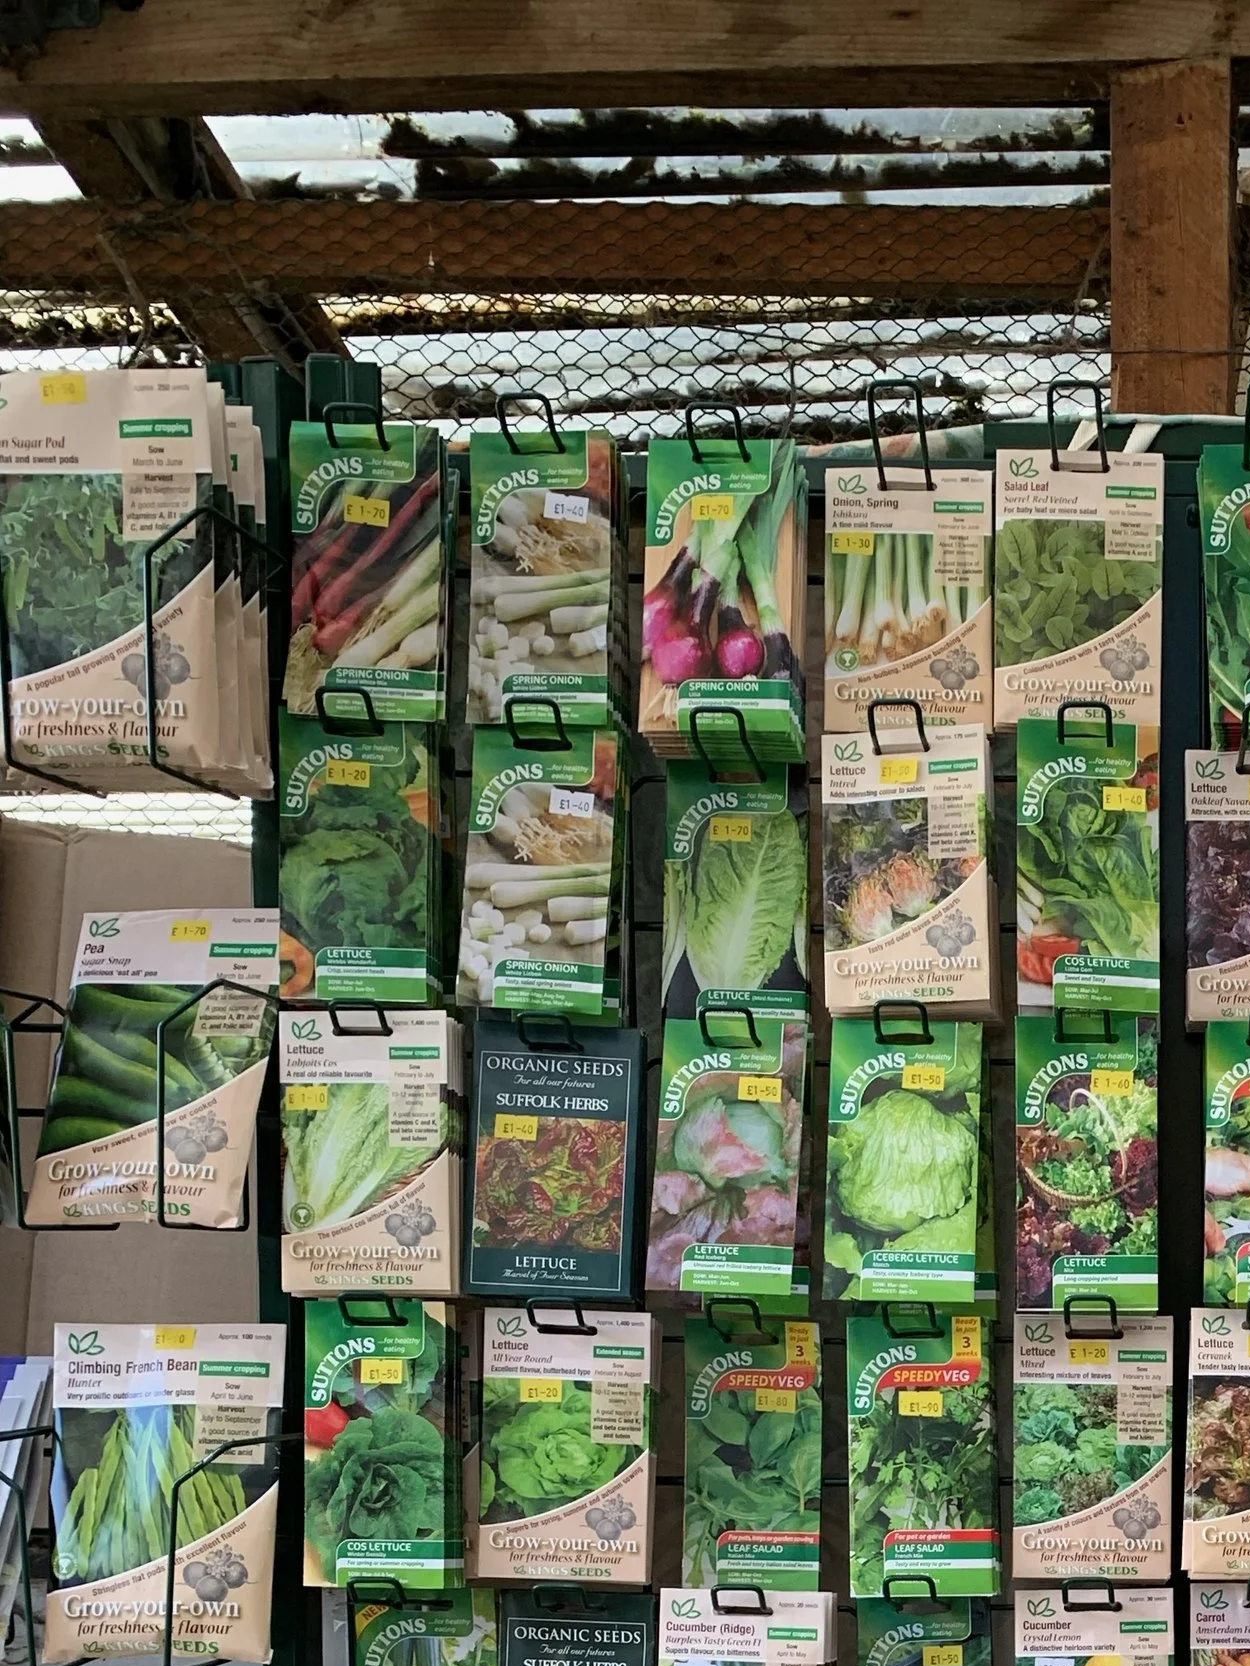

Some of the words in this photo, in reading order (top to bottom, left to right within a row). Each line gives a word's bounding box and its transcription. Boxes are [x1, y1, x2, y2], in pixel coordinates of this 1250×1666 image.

[12, 437, 42, 450] Sugar
[46, 437, 65, 449] Pod
[295, 456, 363, 525] SUTTONS
[1004, 482, 1028, 492] Salad
[1031, 482, 1048, 492] Leaf
[833, 498, 862, 511] Onion,
[867, 498, 898, 511] Spring
[832, 511, 868, 519] Ishikura
[513, 675, 543, 685] SPRING
[546, 676, 582, 686] ONION
[688, 681, 720, 690] SPRING
[724, 682, 759, 691] ONION
[830, 765, 866, 776] Lettuce
[83, 942, 104, 955] Pea
[327, 949, 372, 959] LETTUCE
[106, 955, 131, 966] Snap
[1065, 957, 1085, 968] COS
[1087, 958, 1130, 968] LETTUCE
[486, 1056, 568, 1075] ORGANIC
[573, 1059, 624, 1077] SEEDS
[496, 1093, 554, 1108] SUFFOLK
[559, 1096, 608, 1111] HERBS
[516, 1255, 577, 1270] LETTUCE
[873, 1253, 912, 1262] ICEBERG
[915, 1254, 958, 1263] LETTUCE
[1198, 1339, 1234, 1350] Lettuce
[507, 1354, 525, 1363] Year
[527, 1354, 552, 1364] Round
[1020, 1359, 1046, 1369] Mixed
[68, 1362, 121, 1376] Climbing
[126, 1360, 163, 1373] French
[167, 1359, 197, 1371] Bean
[203, 1364, 231, 1373] Summer
[234, 1365, 266, 1375] cropping
[68, 1378, 102, 1388] Hunter
[489, 1531, 637, 1553] Grow-your-own
[1196, 1613, 1225, 1622] Carrot
[666, 1622, 716, 1634] Cucumber
[720, 1623, 755, 1635] (Ridge)
[1023, 1621, 1071, 1631] Cucumber
[1196, 1626, 1243, 1635] Amsterdam
[1023, 1633, 1050, 1644] Crystal
[1053, 1633, 1081, 1642] Lemon
